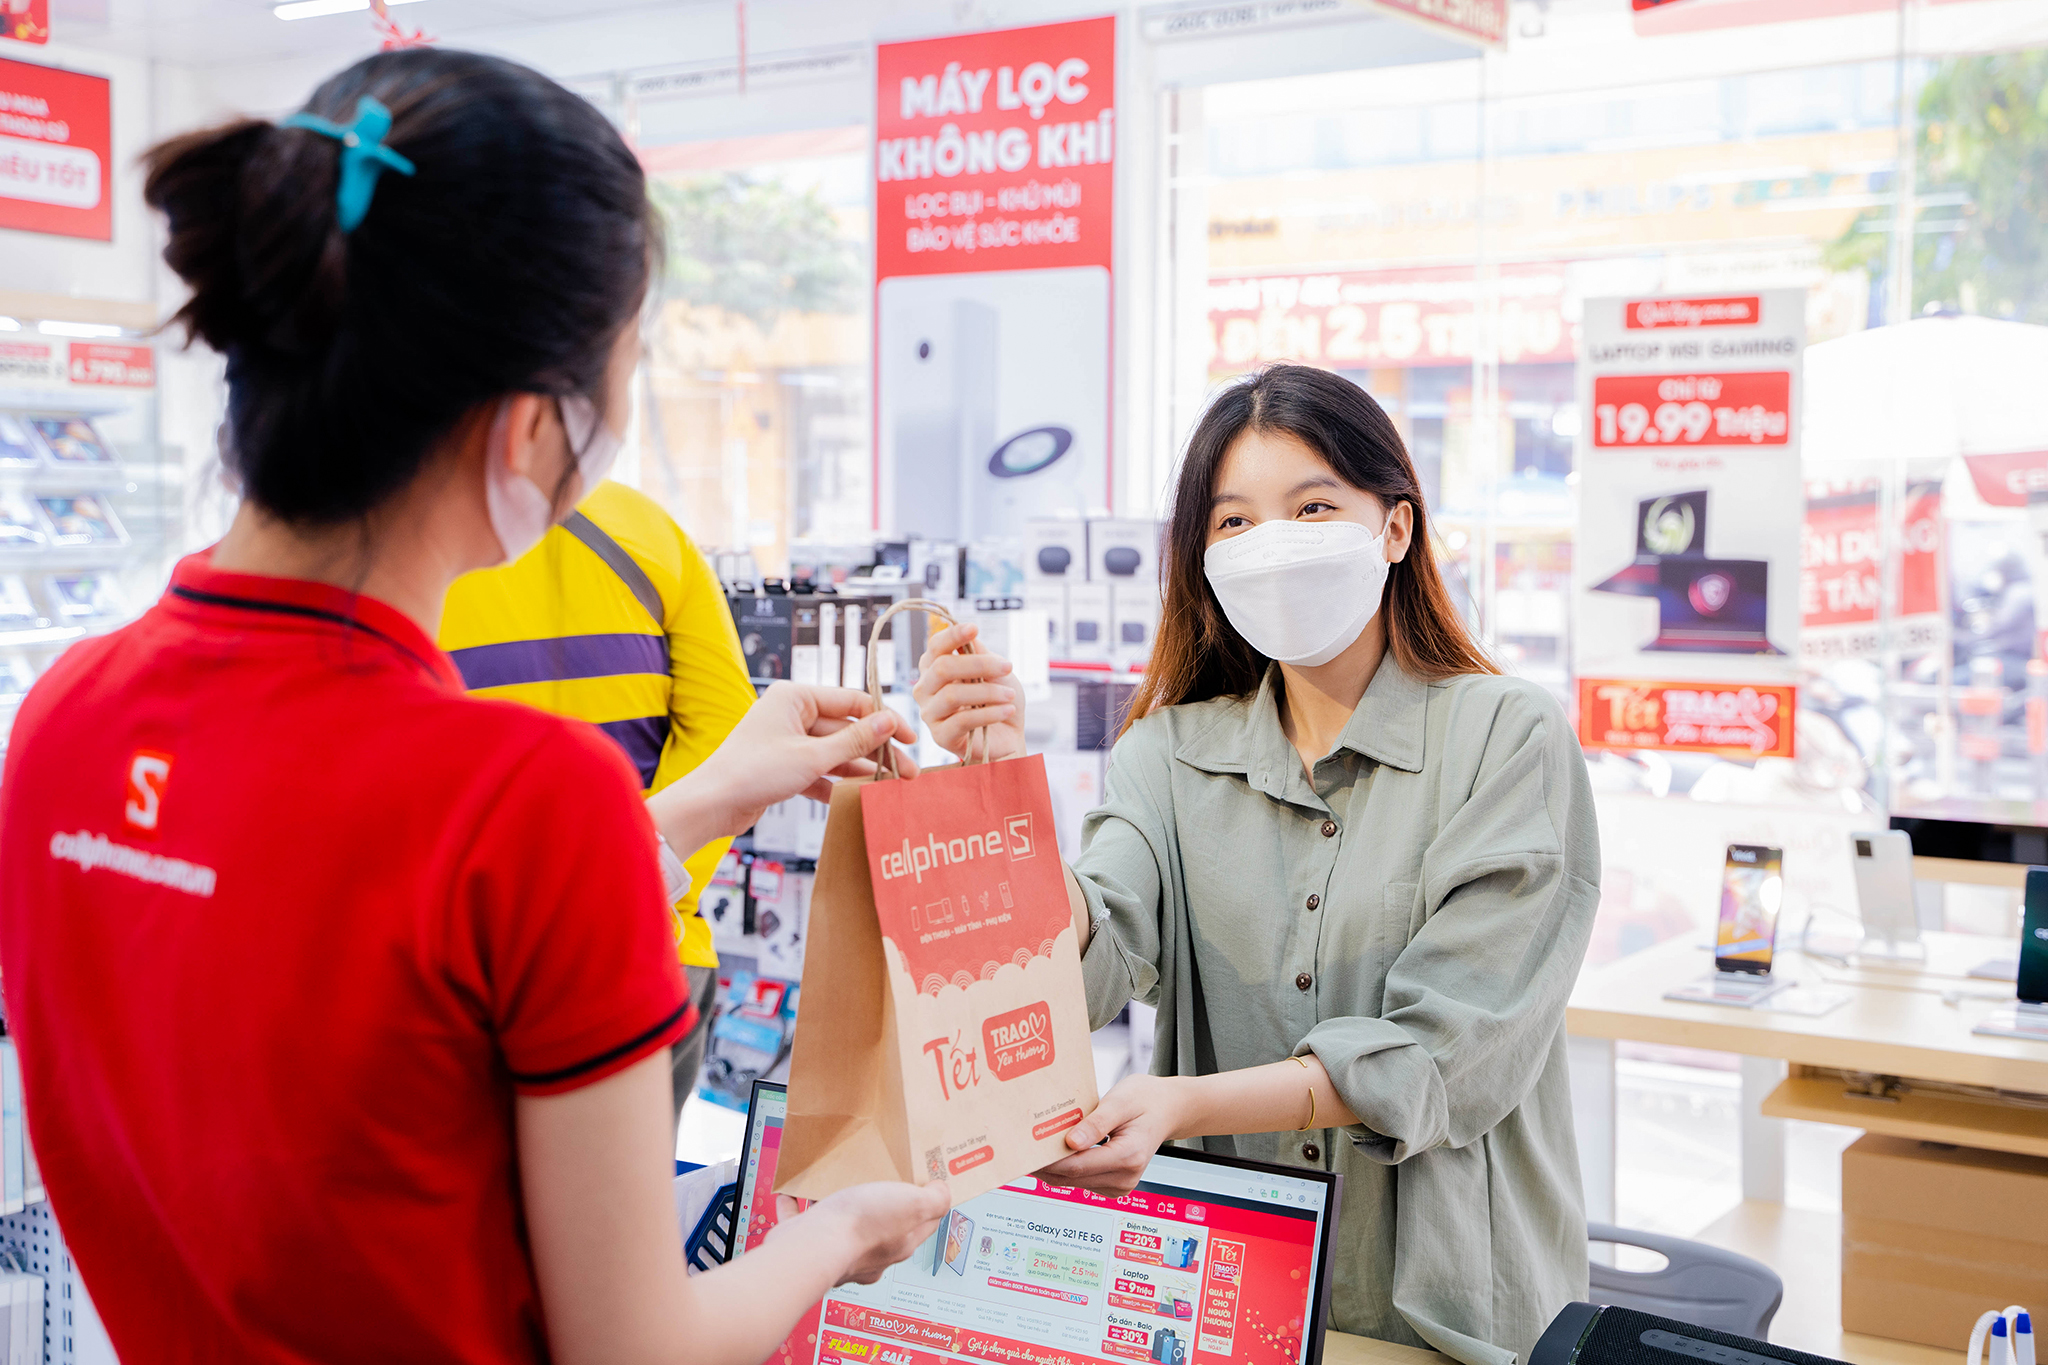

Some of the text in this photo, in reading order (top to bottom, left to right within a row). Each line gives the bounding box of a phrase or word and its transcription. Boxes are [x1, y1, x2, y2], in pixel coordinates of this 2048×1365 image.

[900, 61, 992, 119] MÁY
[997, 57, 1090, 119] LỌC
[878, 108, 1114, 182] KHÔNG KHÍ
[1325, 304, 1422, 359] 2.5
[1589, 343, 1660, 364] LAPTOP
[1596, 401, 1787, 444] 19.99 Triệu
[125, 755, 170, 829] S
[923, 1019, 1030, 1101] Tết TRAO
[996, 1042, 1048, 1072] Yêu thương
[1027, 1221, 1103, 1244] Galaxy S21 FE 5G
[1126, 1222, 1158, 1234] Điện thoại
[1133, 1234, 1157, 1248] 20%
[1217, 1244, 1237, 1261] Tết
[1033, 1258, 1099, 1279] 2 Triệu 2.5 Triệu
[1123, 1268, 1149, 1281] Laptop
[1109, 1293, 1119, 1304] Tết
[1128, 1282, 1137, 1293] 9
[1136, 1285, 1153, 1296] Triệu
[1208, 1288, 1236, 1300] QUÀ TẾT
[1208, 1307, 1231, 1319] NGƯỜI
[1212, 1298, 1229, 1308] CHO
[1107, 1311, 1152, 1330] Ốp dán Balo
[1203, 1316, 1233, 1329] THƯƠNG
[869, 1316, 893, 1329] TRAO
[920, 1327, 953, 1347] thương
[1121, 1329, 1145, 1344] 30%
[828, 1338, 914, 1365] FLASH SALE
[967, 1337, 982, 1352] Gợi
[982, 1339, 989, 1356] ý
[988, 1342, 1007, 1357] chọn
[1007, 1347, 1021, 1360] quà
[1021, 1349, 1036, 1362] cho
[1102, 1340, 1113, 1352] Tết
